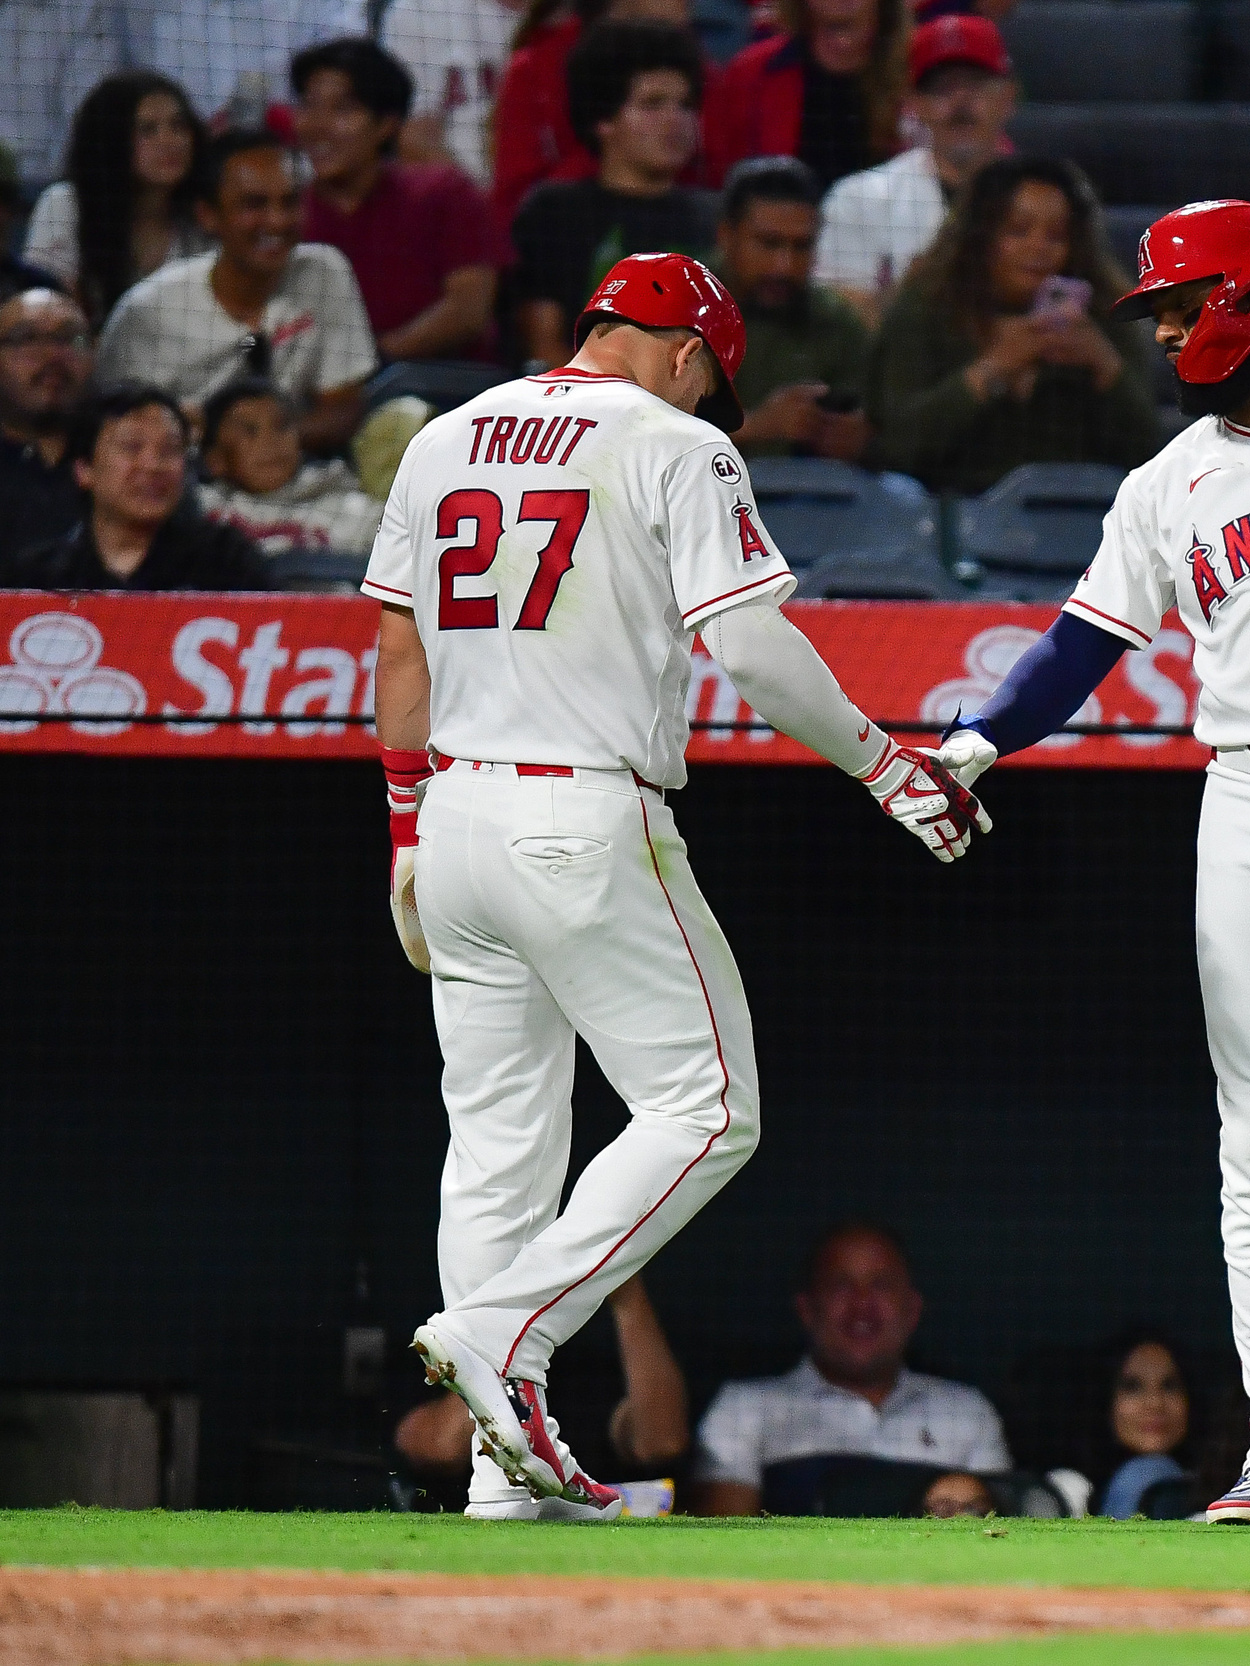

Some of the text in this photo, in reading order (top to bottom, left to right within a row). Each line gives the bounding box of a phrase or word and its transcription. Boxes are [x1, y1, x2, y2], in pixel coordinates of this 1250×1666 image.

[469, 416, 598, 466] TROUT
[714, 460, 739, 477] GA
[731, 495, 770, 562] A
[436, 488, 590, 630] 27
